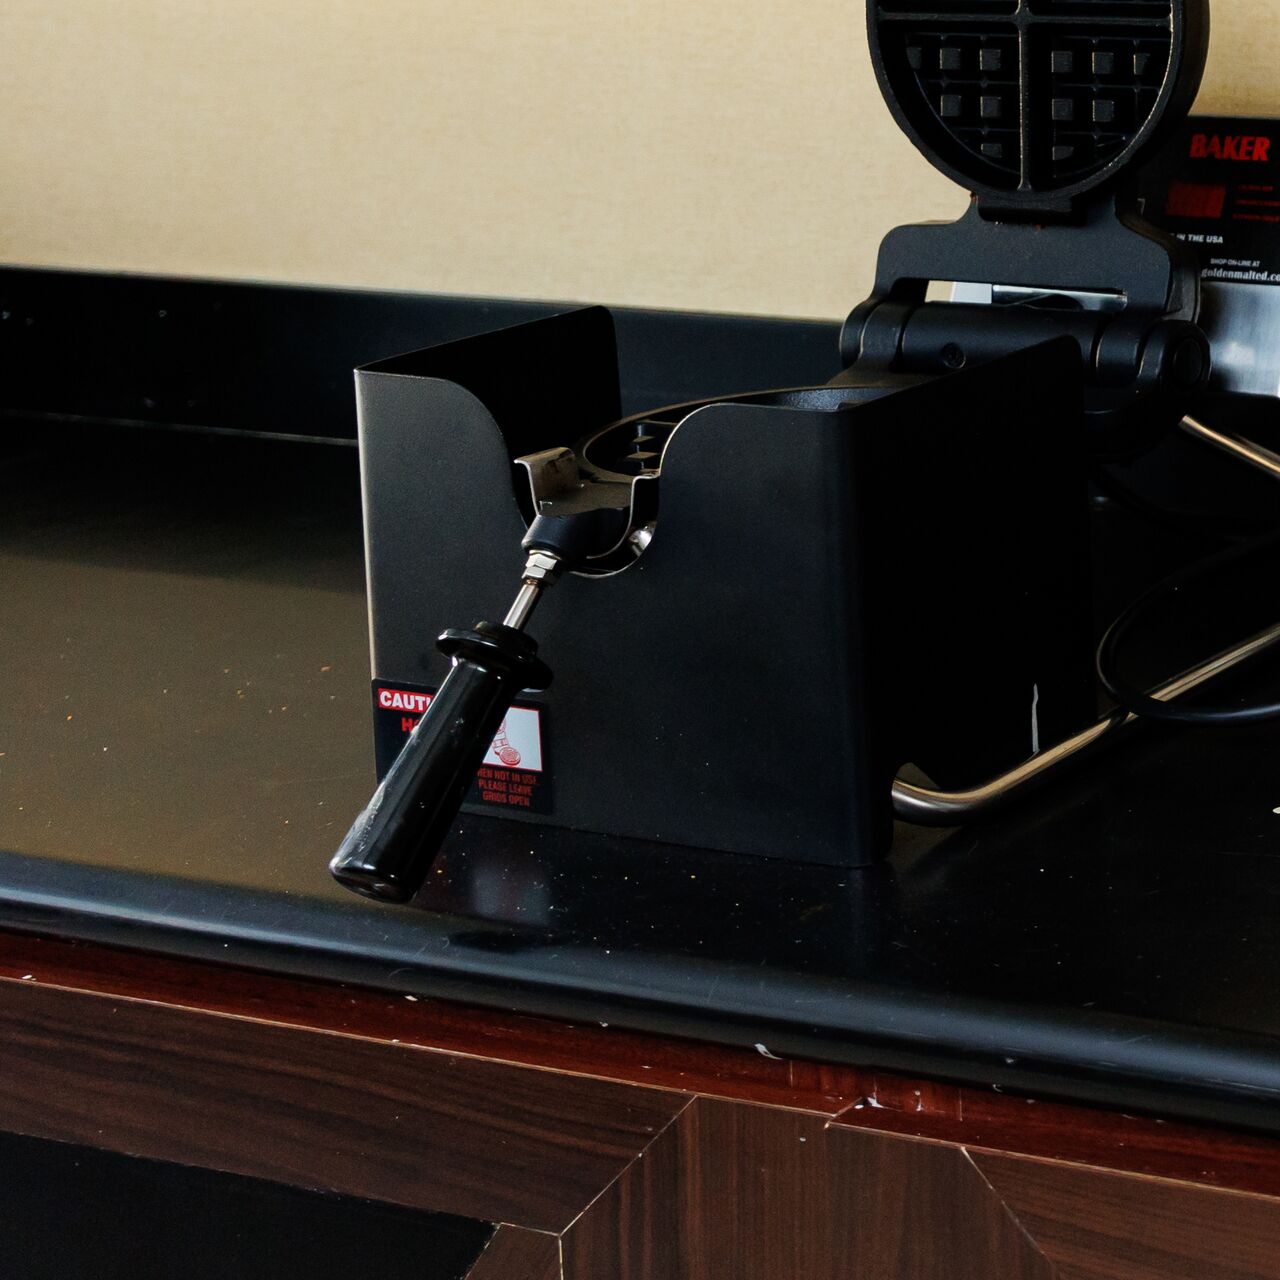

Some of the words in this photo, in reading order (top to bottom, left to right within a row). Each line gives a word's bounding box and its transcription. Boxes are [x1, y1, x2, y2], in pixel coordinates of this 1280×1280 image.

[1189, 134, 1271, 161] BAKER
[1187, 234, 1205, 243] THE
[1206, 235, 1224, 244] USA
[380, 691, 432, 711] CAUT
[479, 778, 507, 792] PLEASE
[508, 794, 530, 807] OPEN
